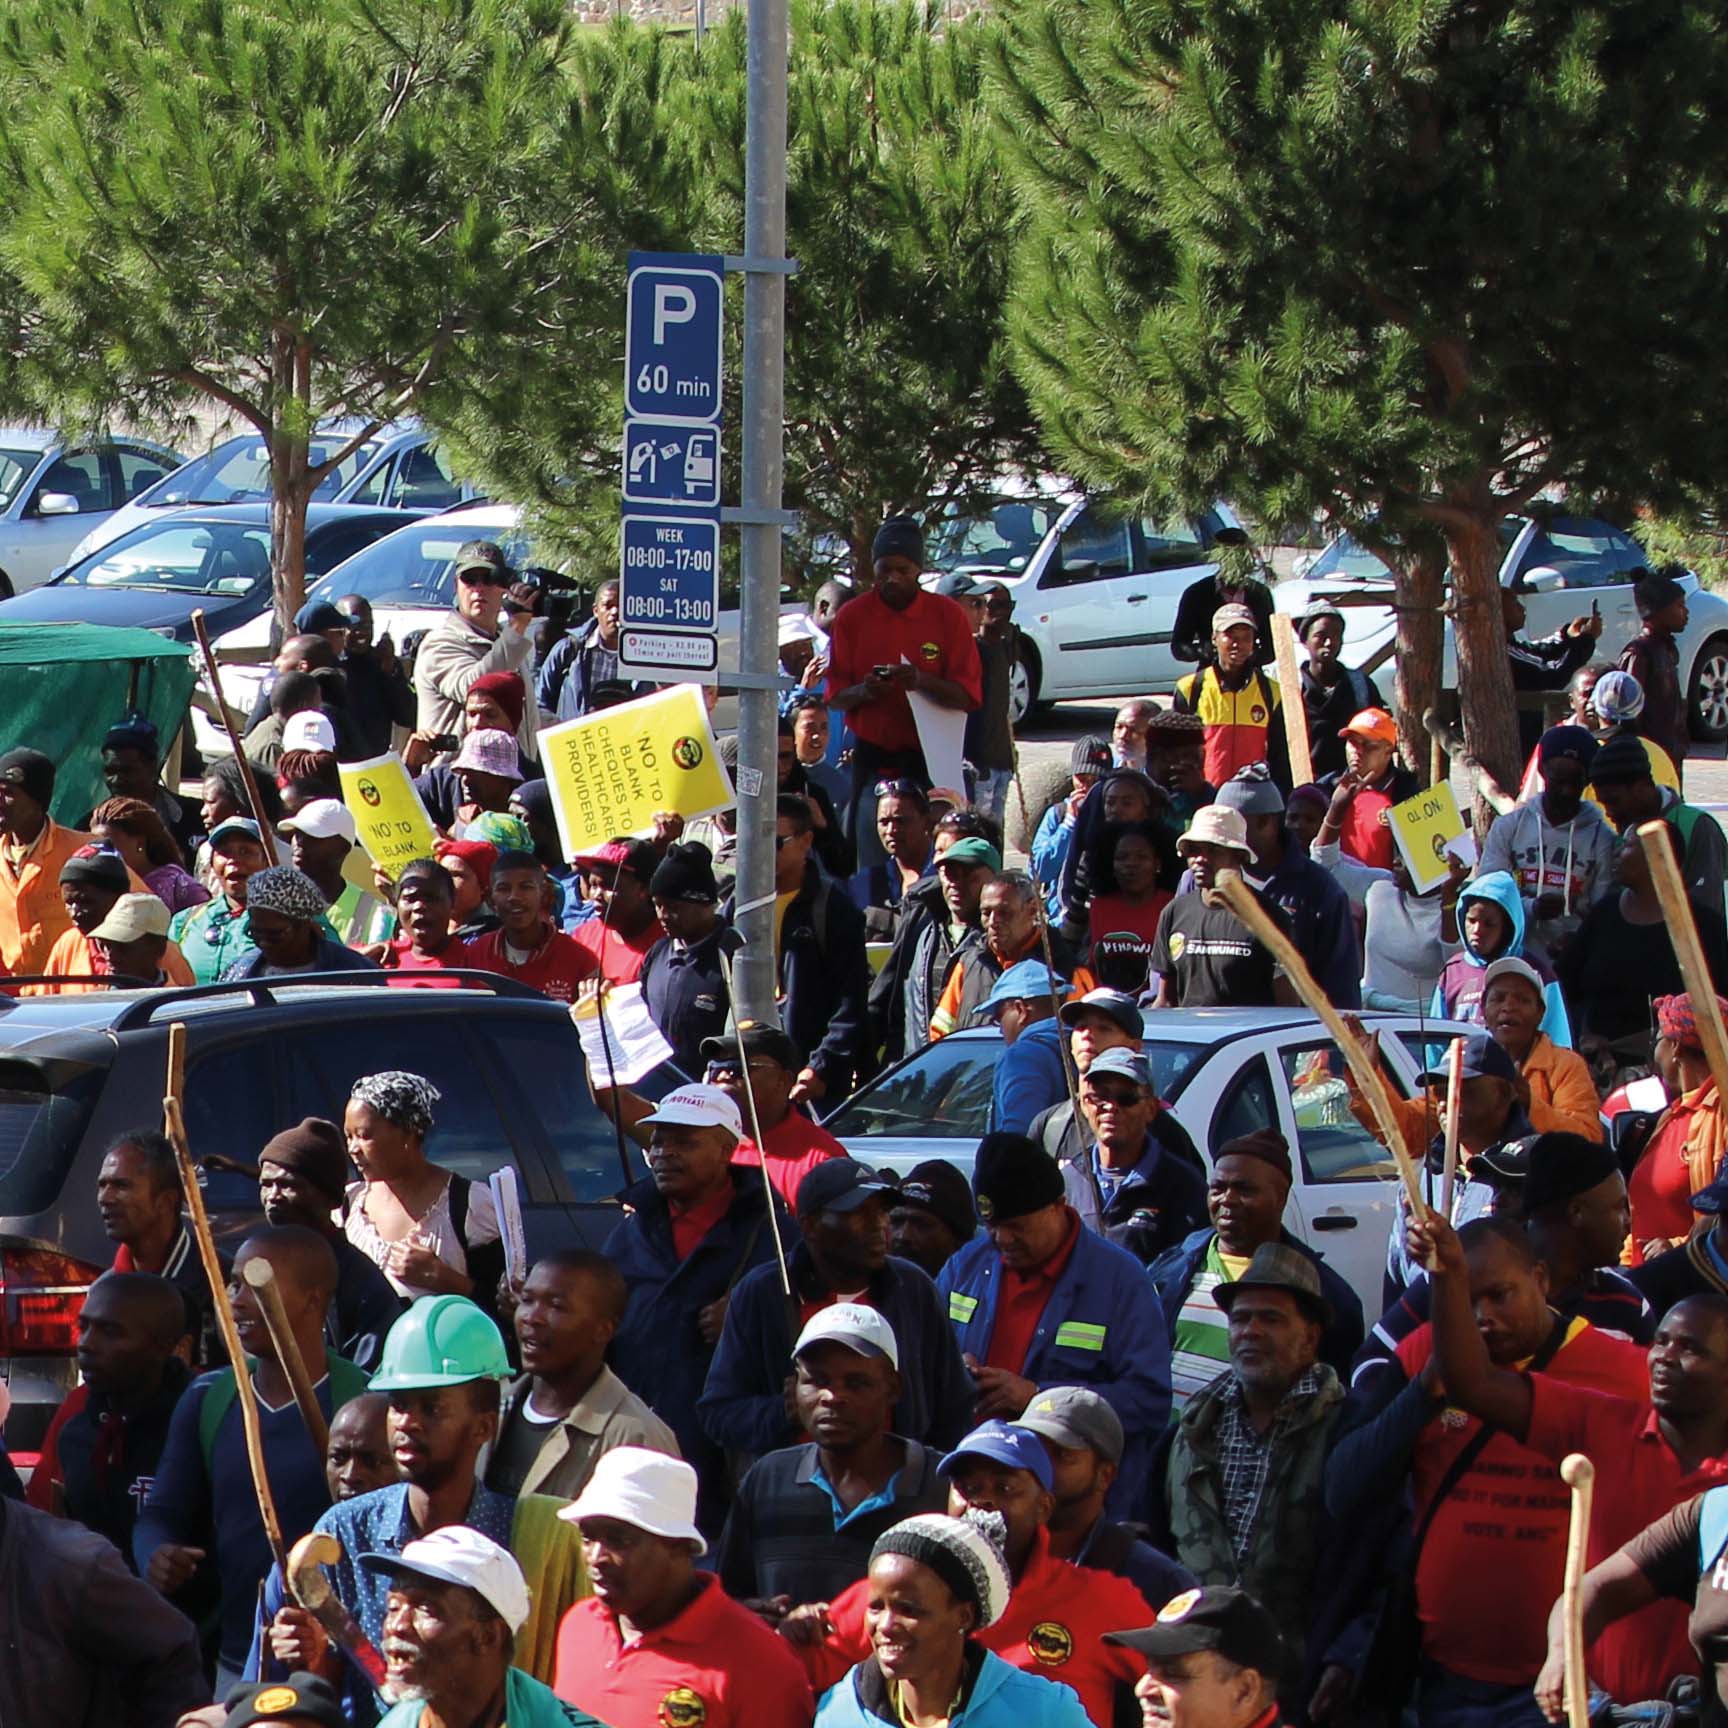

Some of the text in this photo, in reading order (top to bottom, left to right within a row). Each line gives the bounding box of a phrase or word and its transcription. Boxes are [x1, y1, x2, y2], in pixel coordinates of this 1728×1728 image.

[653, 283, 696, 345] P
[636, 363, 710, 397] 60 min
[655, 527, 684, 544] WEEK
[659, 577, 678, 593] SAT
[565, 740, 598, 838] PROVIDERS!
[580, 729, 616, 838] HEALTHCARE
[597, 726, 633, 831] CHEQUES TO
[620, 745, 646, 800] BLANK
[649, 780, 664, 802] TO
[395, 820, 413, 835] TO
[382, 841, 419, 858] BLANK
